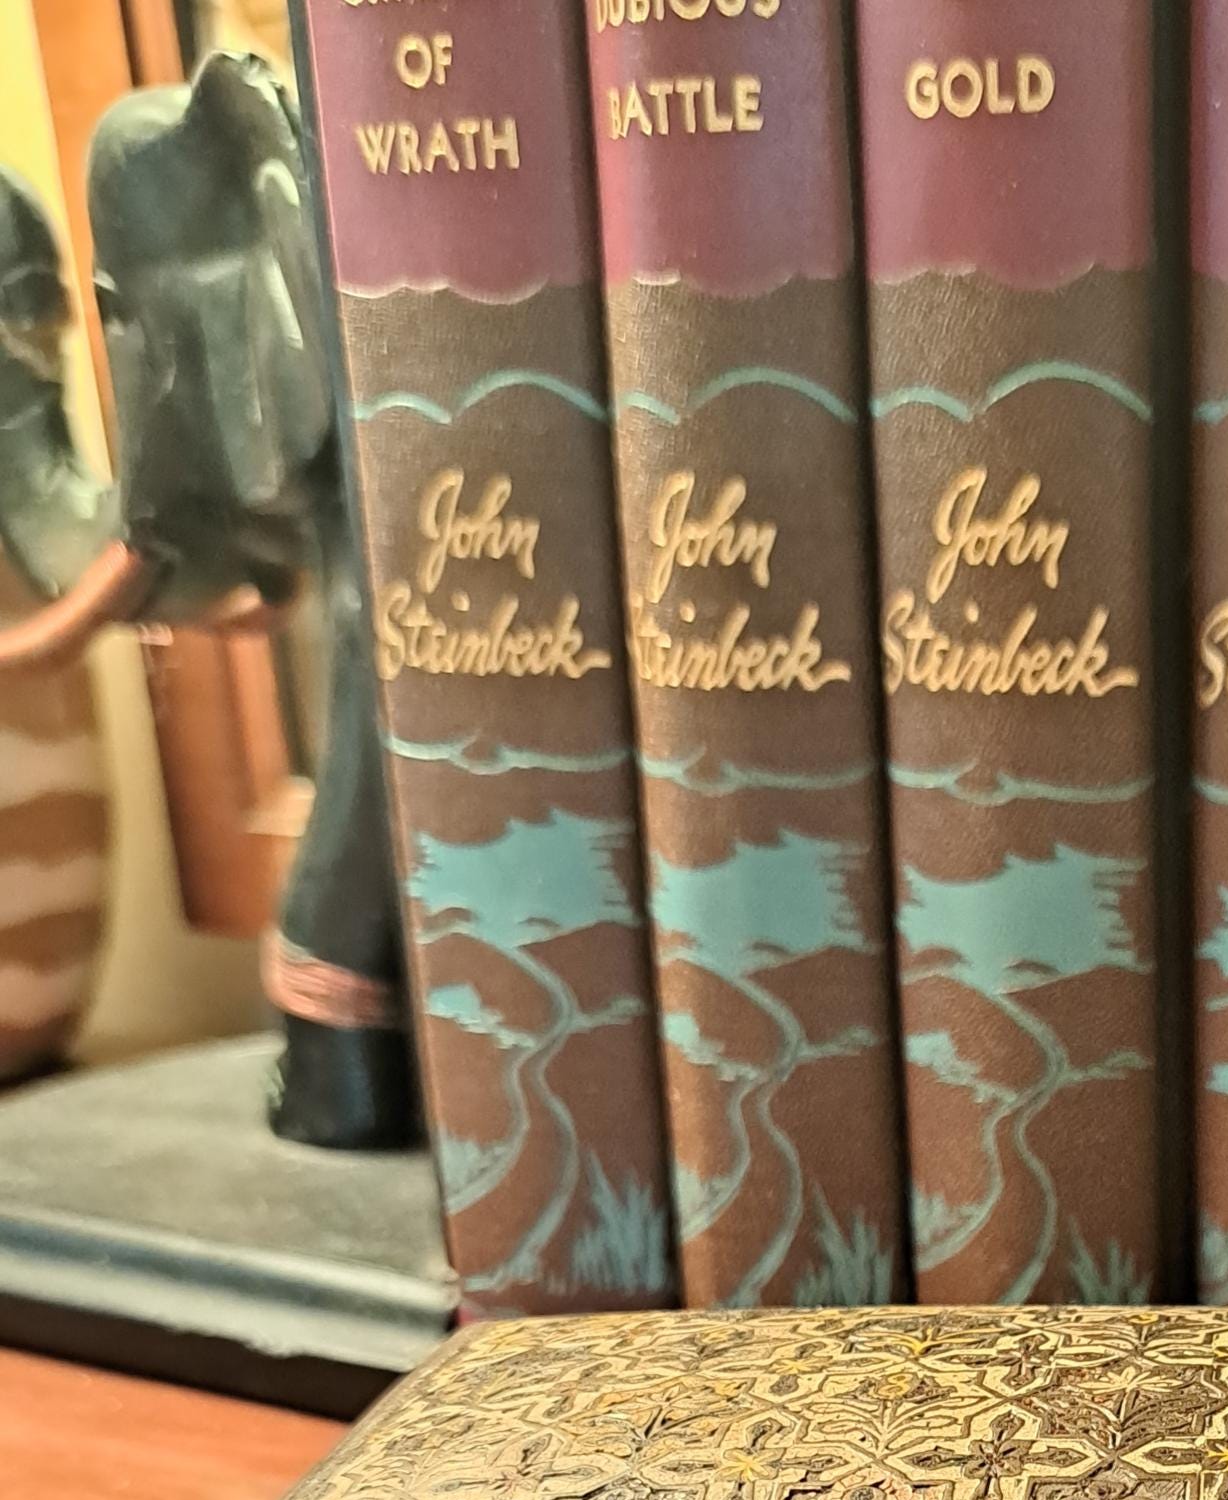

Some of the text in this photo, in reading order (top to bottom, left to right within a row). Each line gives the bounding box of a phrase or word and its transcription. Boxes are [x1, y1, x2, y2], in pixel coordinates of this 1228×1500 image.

[394, 33, 454, 89] OF
[608, 74, 764, 140] BATTLE
[905, 55, 1056, 119] GOLD
[355, 117, 520, 175] WRATH
[418, 467, 540, 594] John
[647, 469, 777, 603] John
[927, 465, 1069, 603] John
[376, 579, 612, 680] Steinbeck
[883, 589, 1140, 697] Steinbeck
